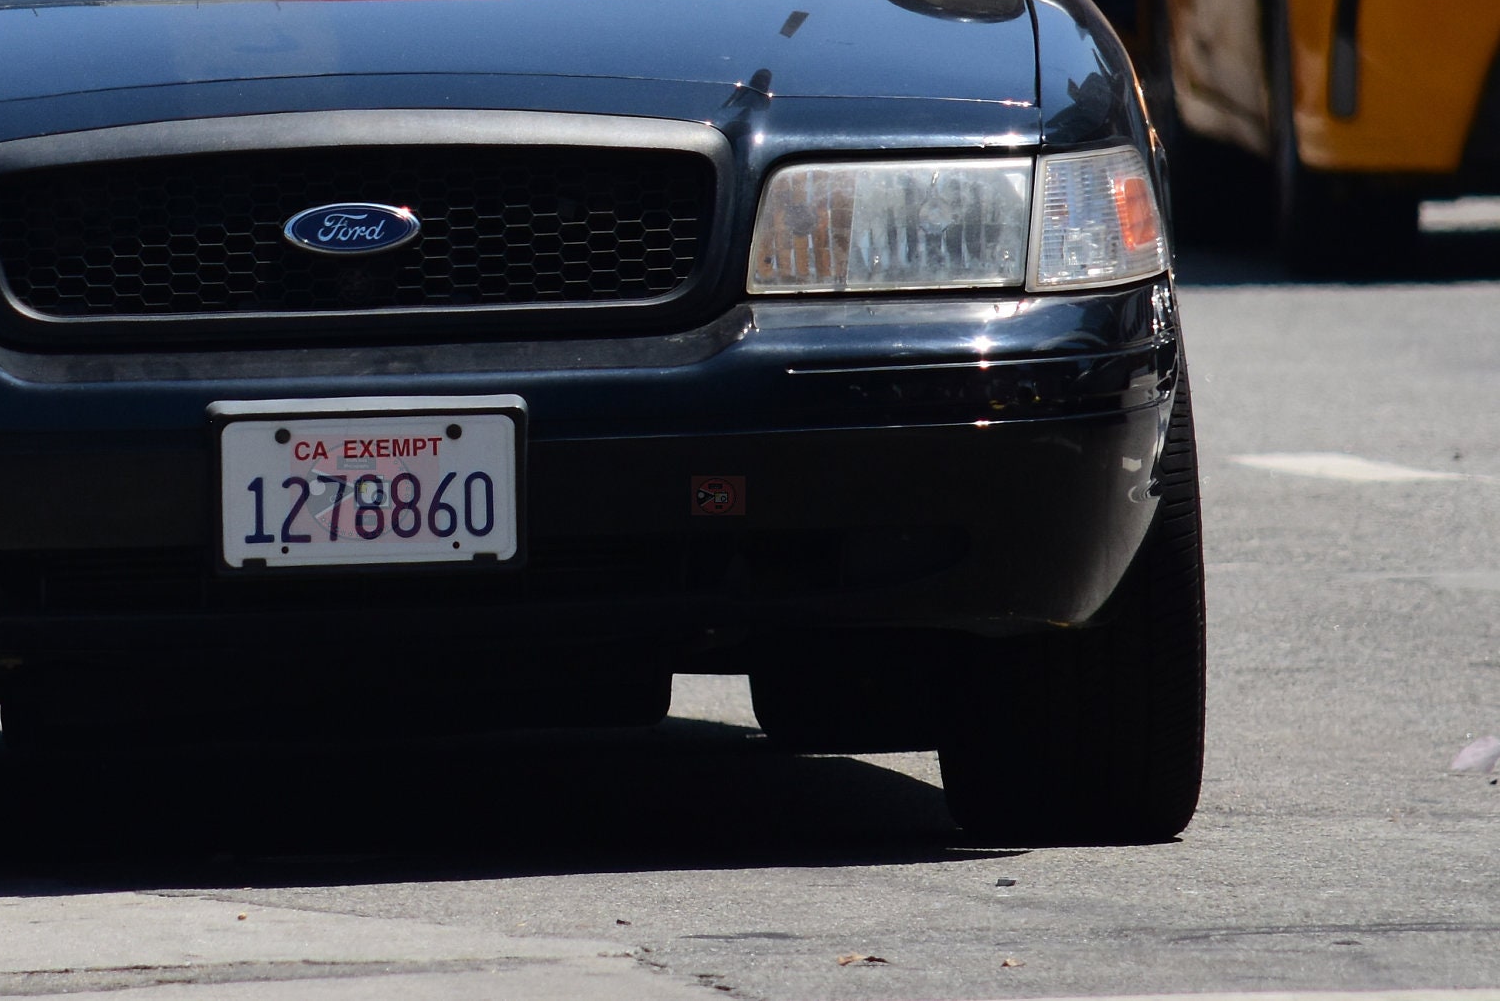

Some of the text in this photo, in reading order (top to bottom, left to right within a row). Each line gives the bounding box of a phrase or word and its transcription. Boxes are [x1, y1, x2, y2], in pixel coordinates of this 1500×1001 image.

[318, 213, 386, 242] Ford
[294, 437, 443, 461] CA EXEMPT
[245, 471, 494, 544] 1278860
